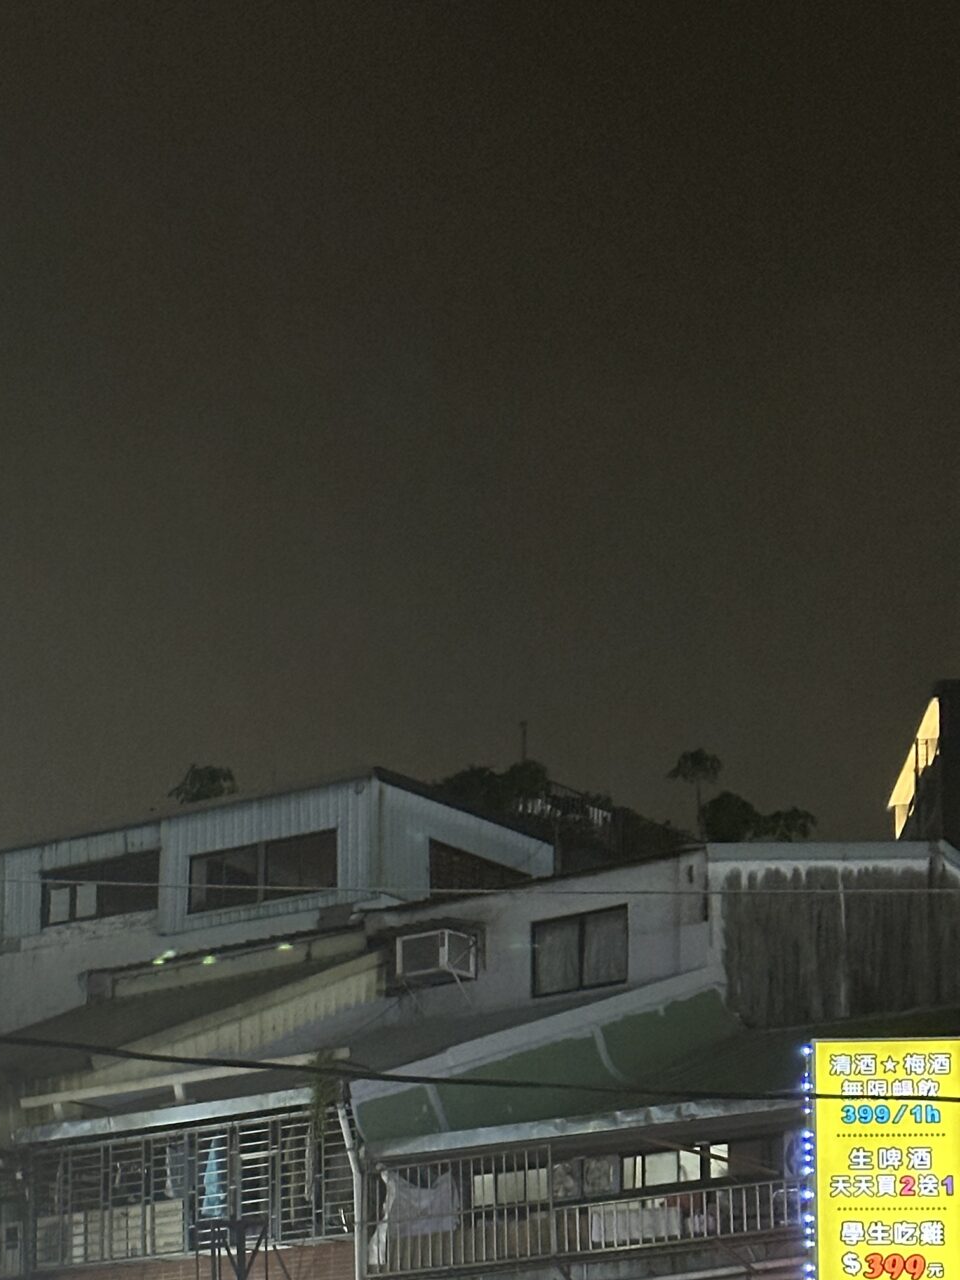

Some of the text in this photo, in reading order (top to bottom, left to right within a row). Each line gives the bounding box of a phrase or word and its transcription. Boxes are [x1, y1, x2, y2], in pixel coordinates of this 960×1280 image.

[841, 1079, 940, 1101] 無限暢飲
[841, 1104, 941, 1124] 399/1h
[848, 1147, 932, 1170] 生啤酒
[830, 1174, 954, 1197] 天天買2送1
[840, 1221, 945, 1246] 學生吃雞
